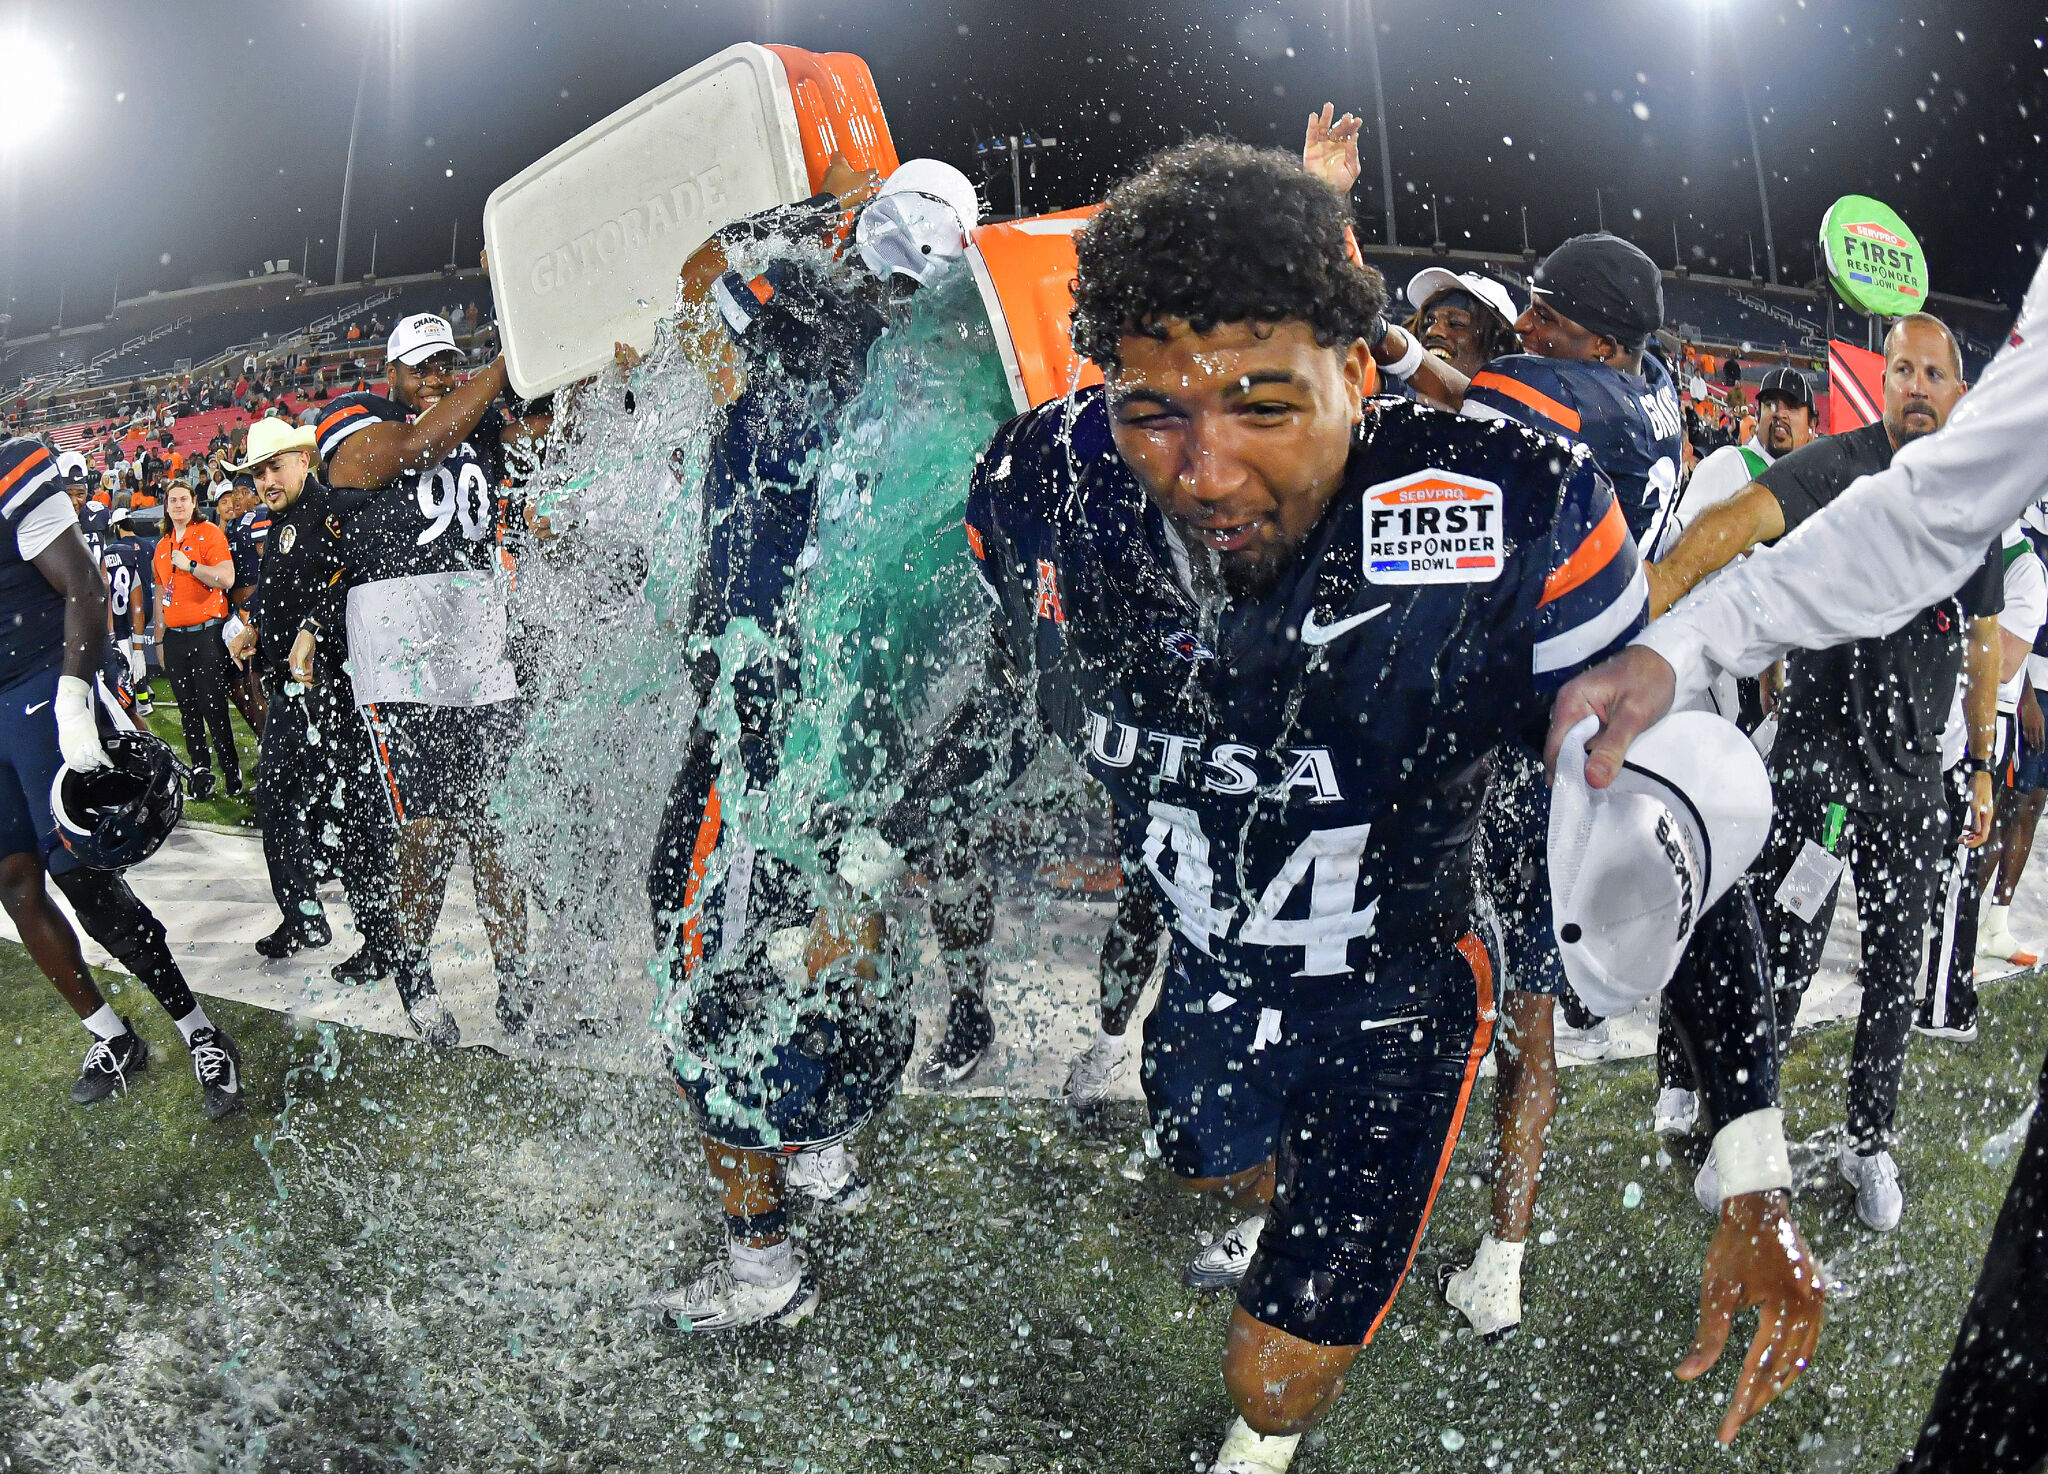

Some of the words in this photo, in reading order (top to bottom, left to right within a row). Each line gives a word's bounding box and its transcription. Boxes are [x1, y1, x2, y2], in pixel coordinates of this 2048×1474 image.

[531, 164, 727, 296] GATORADE
[1856, 225, 1898, 245] SERVPRO
[1844, 236, 1913, 273] F1RST
[1847, 258, 1919, 287] RESPONDER
[416, 462, 490, 546] 90
[1399, 487, 1464, 502] SERVPRO
[1371, 504, 1495, 539] F1RST
[1370, 537, 1495, 557] RESPONDER
[1411, 558, 1455, 572] BOWL
[1087, 710, 1345, 802] UTSA
